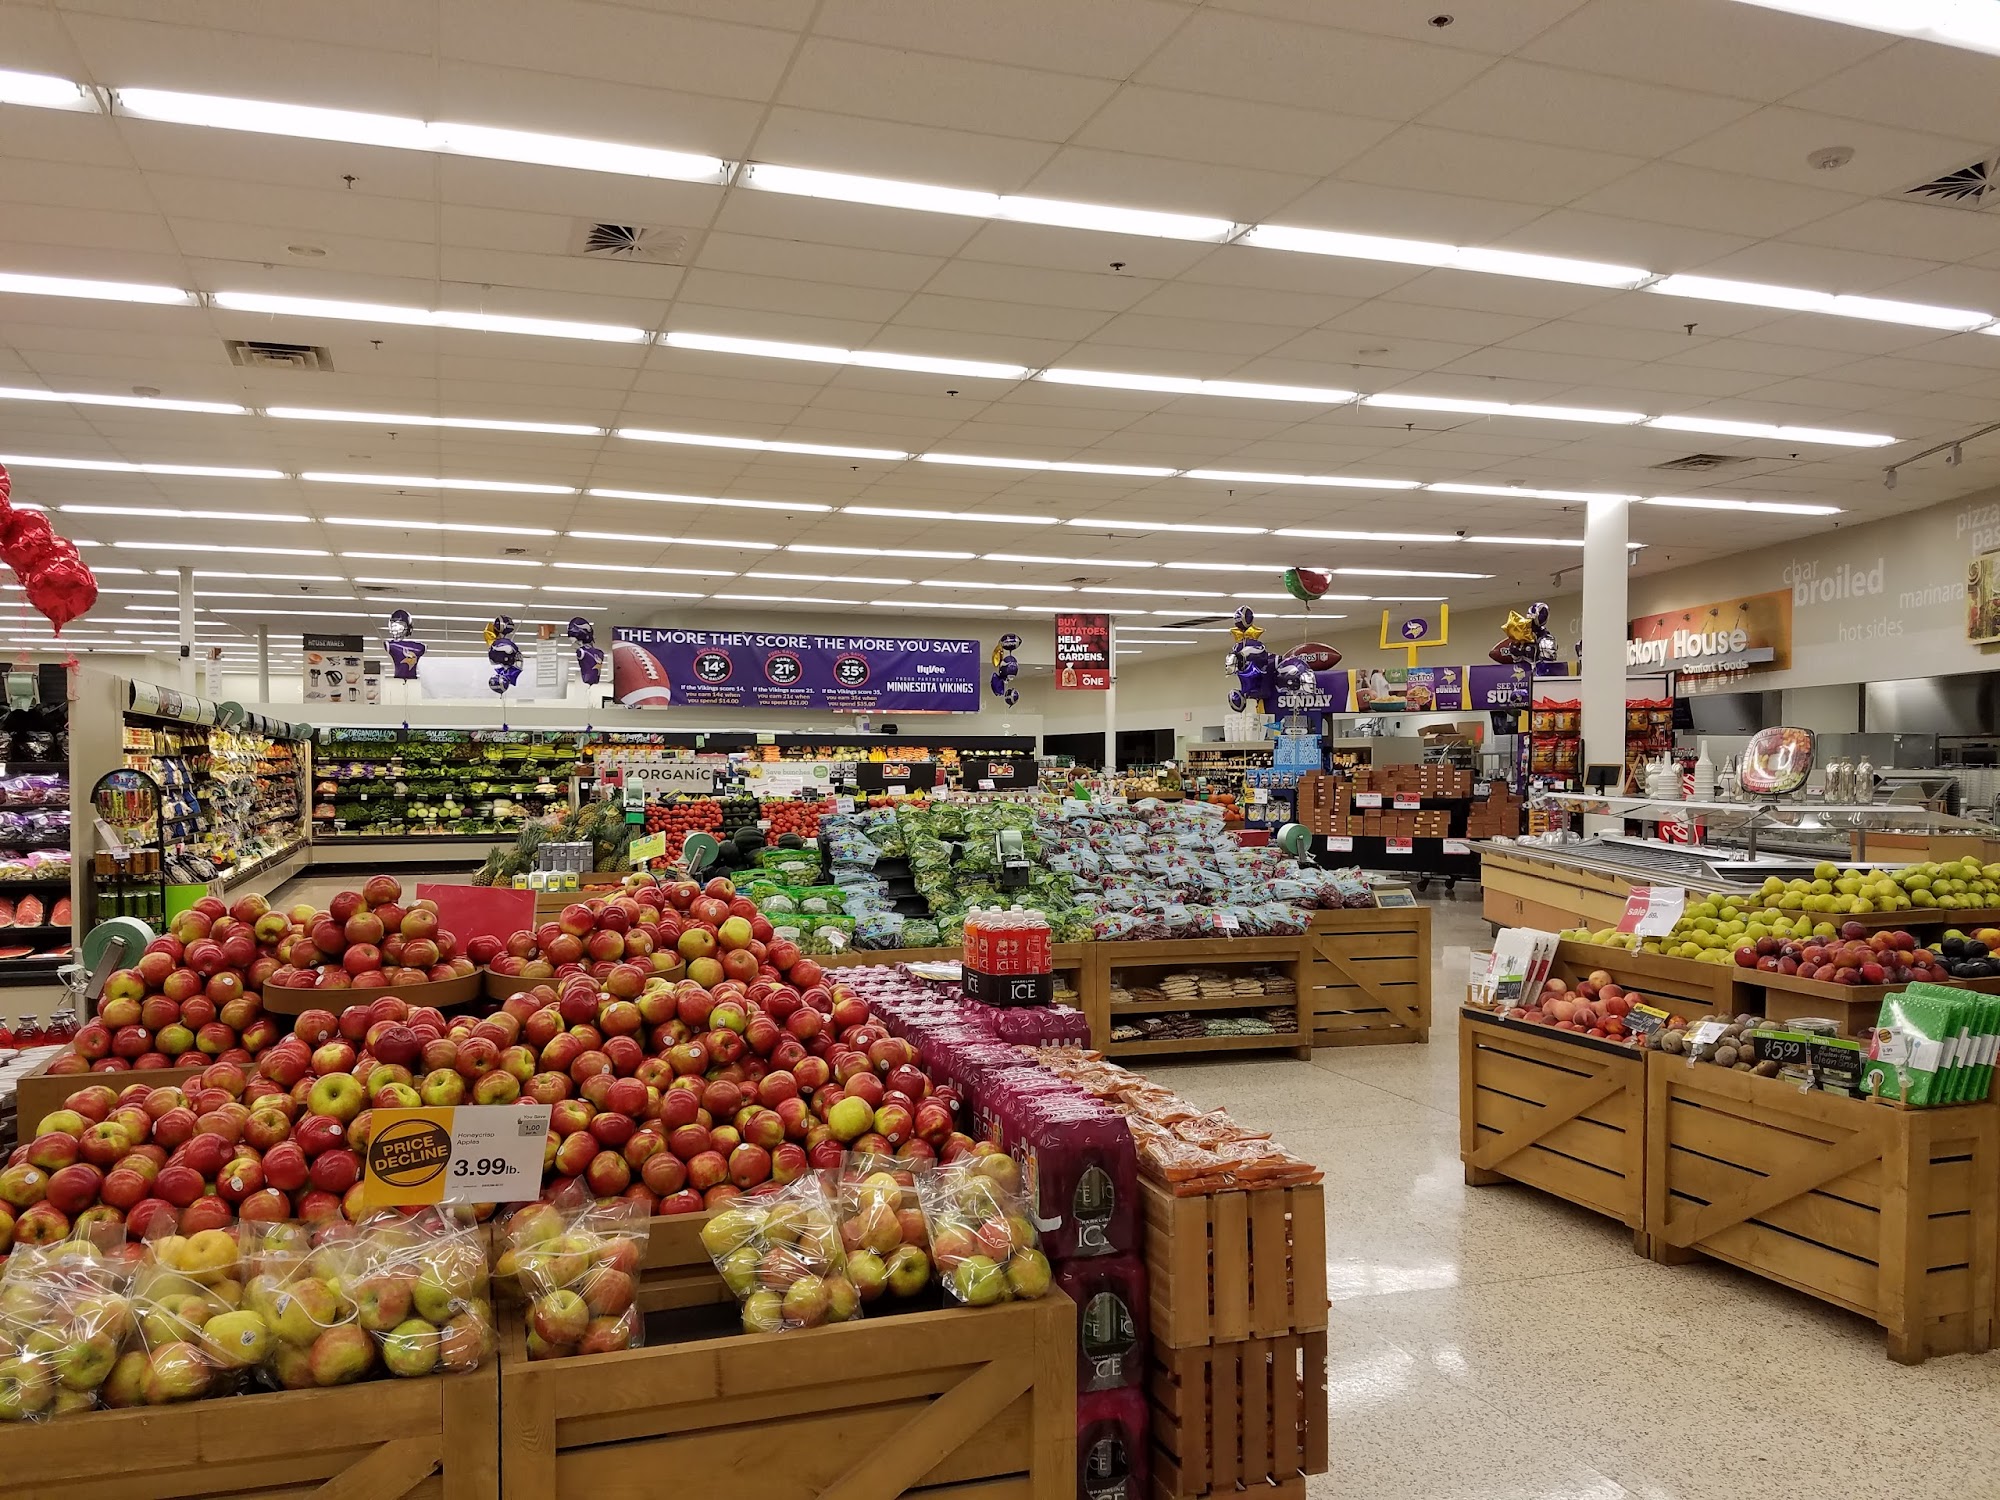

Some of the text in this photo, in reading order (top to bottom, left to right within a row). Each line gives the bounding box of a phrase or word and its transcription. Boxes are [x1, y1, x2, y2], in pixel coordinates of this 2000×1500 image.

[1957, 503, 2000, 540] pizza
[1783, 558, 1819, 584] char
[1794, 558, 1884, 607] broiled
[1900, 580, 1964, 609] marinara
[1058, 618, 1077, 626] BUY
[1058, 627, 1107, 635] POTATOES.
[1839, 616, 1904, 642] hot sides
[617, 629, 973, 654] THE MORE THEY SCORE, THE MORE YOU SAVE.
[1058, 635, 1082, 643] HELP
[1058, 644, 1089, 652] PLANT
[1626, 628, 1747, 667] ickory House
[1058, 653, 1104, 661] GARDENS.
[702, 661, 725, 672] 14¢
[774, 663, 795, 674] 21¢
[841, 665, 864, 676] 35¢
[1682, 659, 1750, 674] Comfort Foods
[887, 681, 973, 693] MINNESOTA VIKINGS
[1082, 677, 1104, 685] ONE
[1277, 694, 1333, 708] SUNDAY
[884, 764, 910, 776] Dole
[989, 763, 1013, 775] Dole
[1627, 907, 1646, 916] sale
[968, 975, 979, 993] ICE
[1011, 984, 1037, 999] ICE
[1756, 1030, 1775, 1039] fresh
[1812, 1036, 1830, 1045] fresh
[1765, 1040, 1799, 1061] $5.99
[1814, 1054, 1837, 1066] Clean
[383, 1136, 434, 1157] PRICE
[375, 1145, 448, 1171] DECLINE
